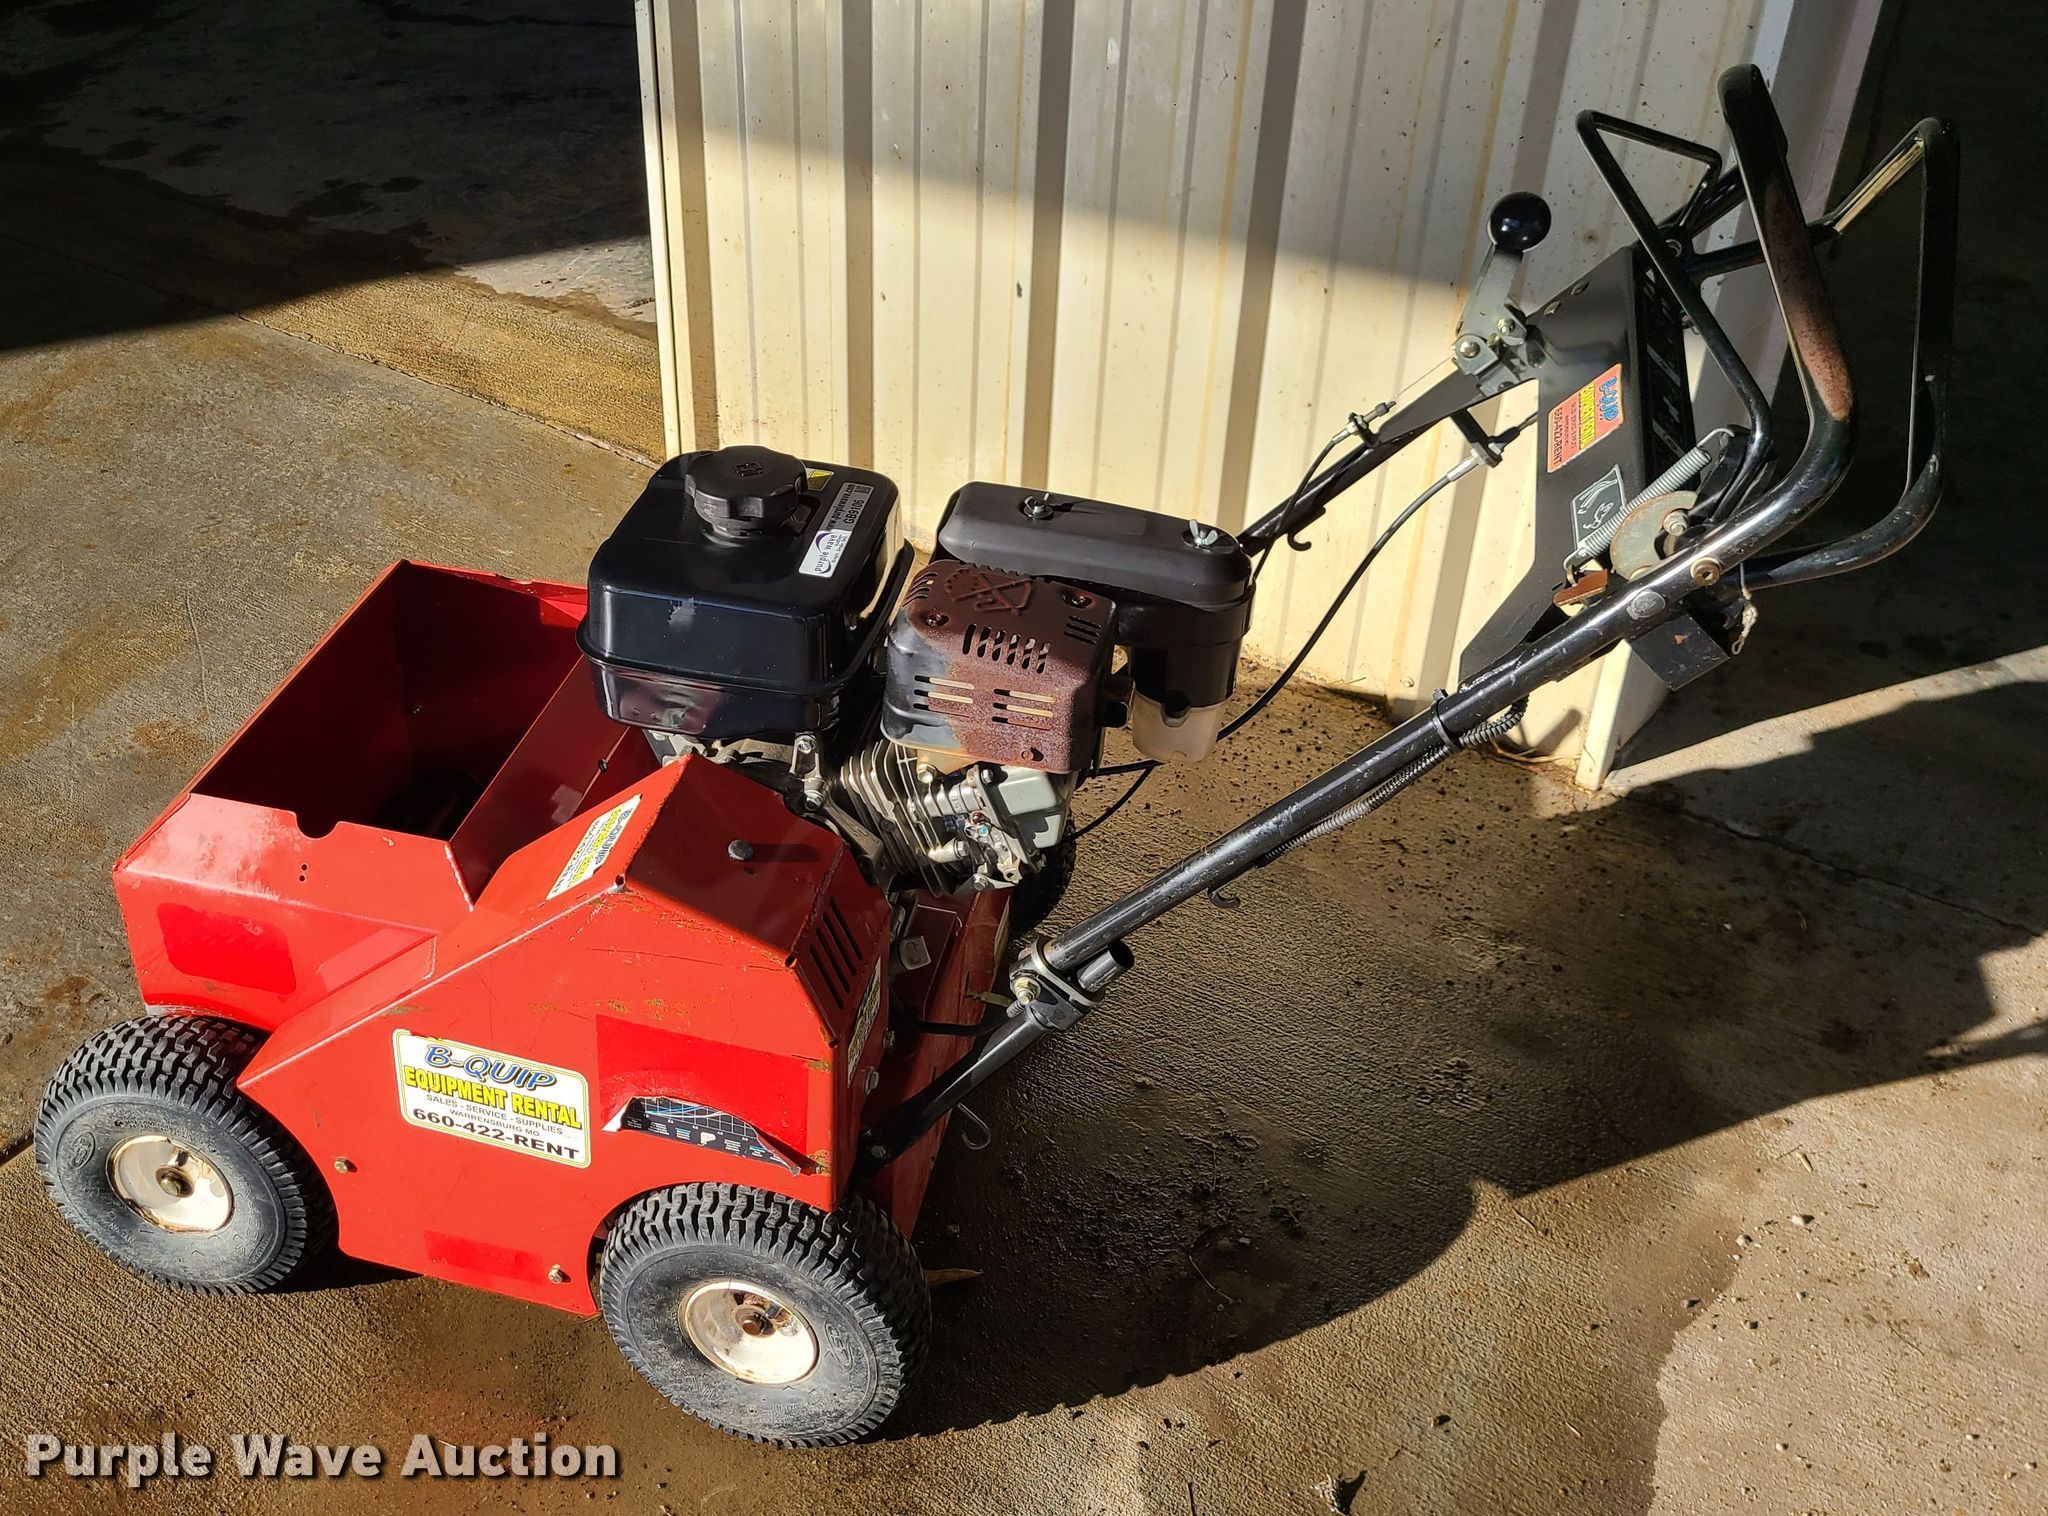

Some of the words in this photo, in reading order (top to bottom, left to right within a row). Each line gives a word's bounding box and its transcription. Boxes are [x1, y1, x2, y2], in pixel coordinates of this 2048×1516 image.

[843, 499, 865, 525] GB9106
[814, 550, 829, 572] purple
[825, 534, 838, 550] wave
[424, 1043, 557, 1091] B-QUIP
[404, 1065, 508, 1110] EQUIPMENT
[512, 1091, 583, 1130] RENTAL
[426, 1093, 459, 1108] SALES
[466, 1104, 507, 1121] SERVICE
[515, 1116, 563, 1135] SUPPLIES
[413, 1108, 579, 1159] 660-422-RENT
[450, 1108, 523, 1133] WARRENSBURG
[525, 1127, 540, 1137] MO
